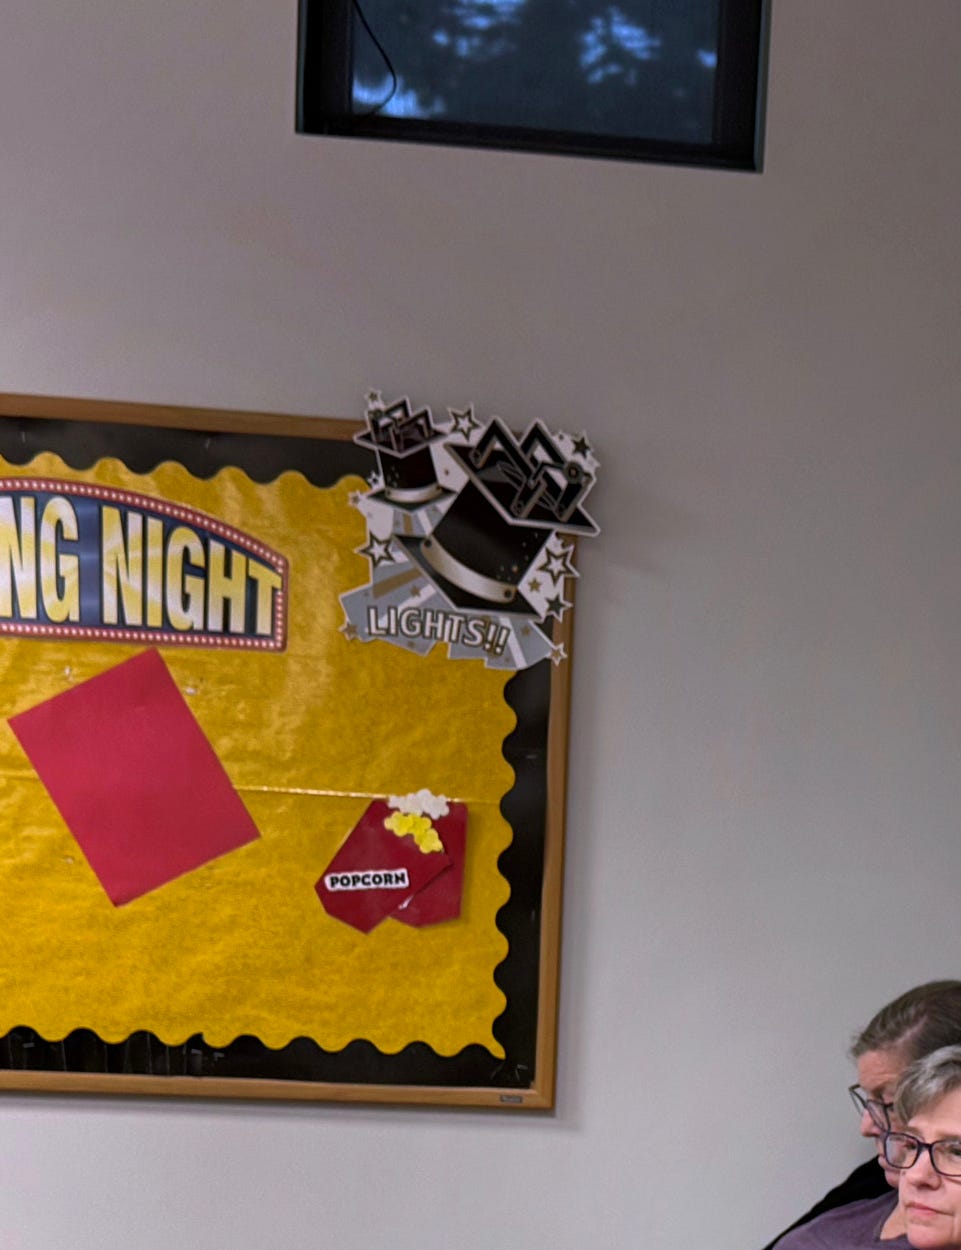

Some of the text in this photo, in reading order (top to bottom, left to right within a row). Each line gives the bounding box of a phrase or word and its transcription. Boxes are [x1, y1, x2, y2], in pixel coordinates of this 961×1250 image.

[102, 504, 283, 637] NIGHT
[366, 604, 511, 655] LIGHTS!!
[329, 871, 406, 889] POPCORN
